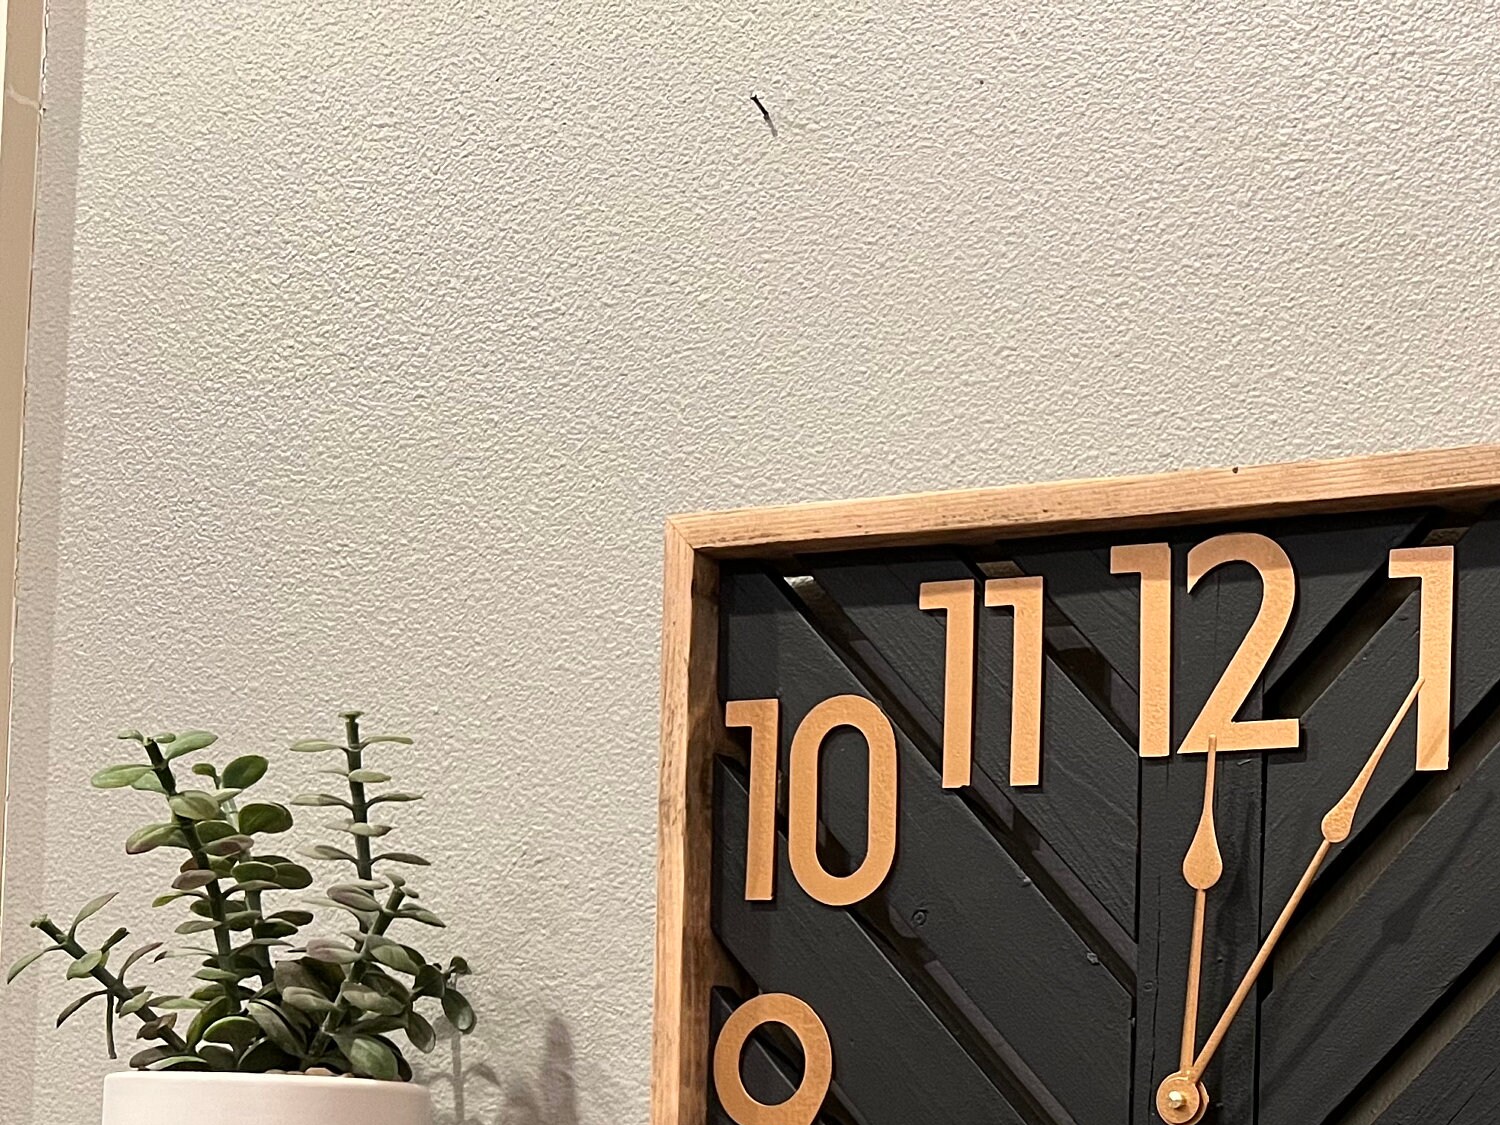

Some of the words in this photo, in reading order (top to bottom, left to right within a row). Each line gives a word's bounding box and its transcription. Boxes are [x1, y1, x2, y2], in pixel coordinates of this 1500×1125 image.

[919, 576, 1043, 788] 11
[1110, 532, 1300, 757] 12
[1388, 545, 1455, 771] 1
[725, 694, 897, 906] 10
